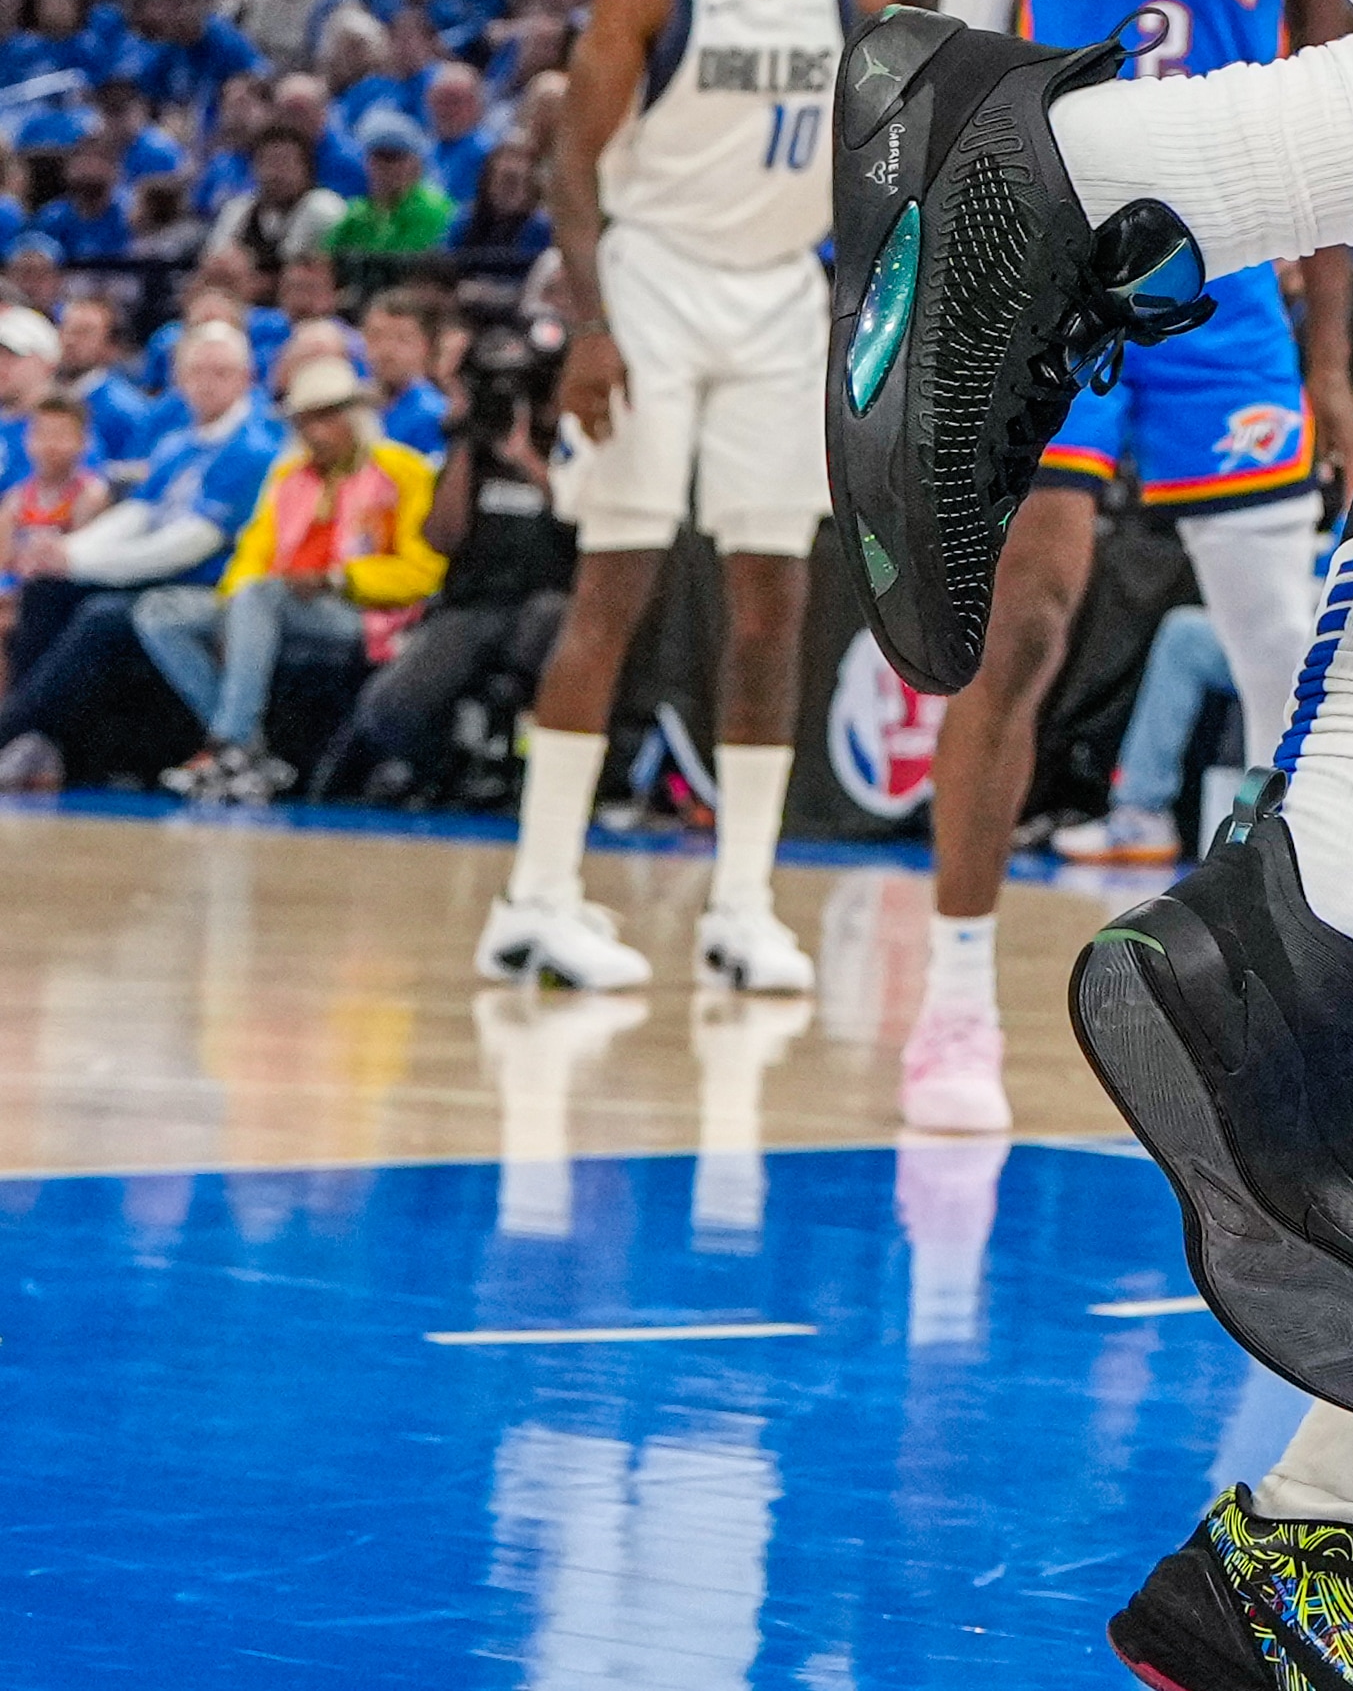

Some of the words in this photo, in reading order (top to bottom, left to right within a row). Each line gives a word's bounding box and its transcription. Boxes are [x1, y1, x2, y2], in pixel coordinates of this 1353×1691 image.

[697, 46, 833, 93] DALLAS
[763, 103, 823, 171] 10
[887, 122, 906, 197] GABRIELA
